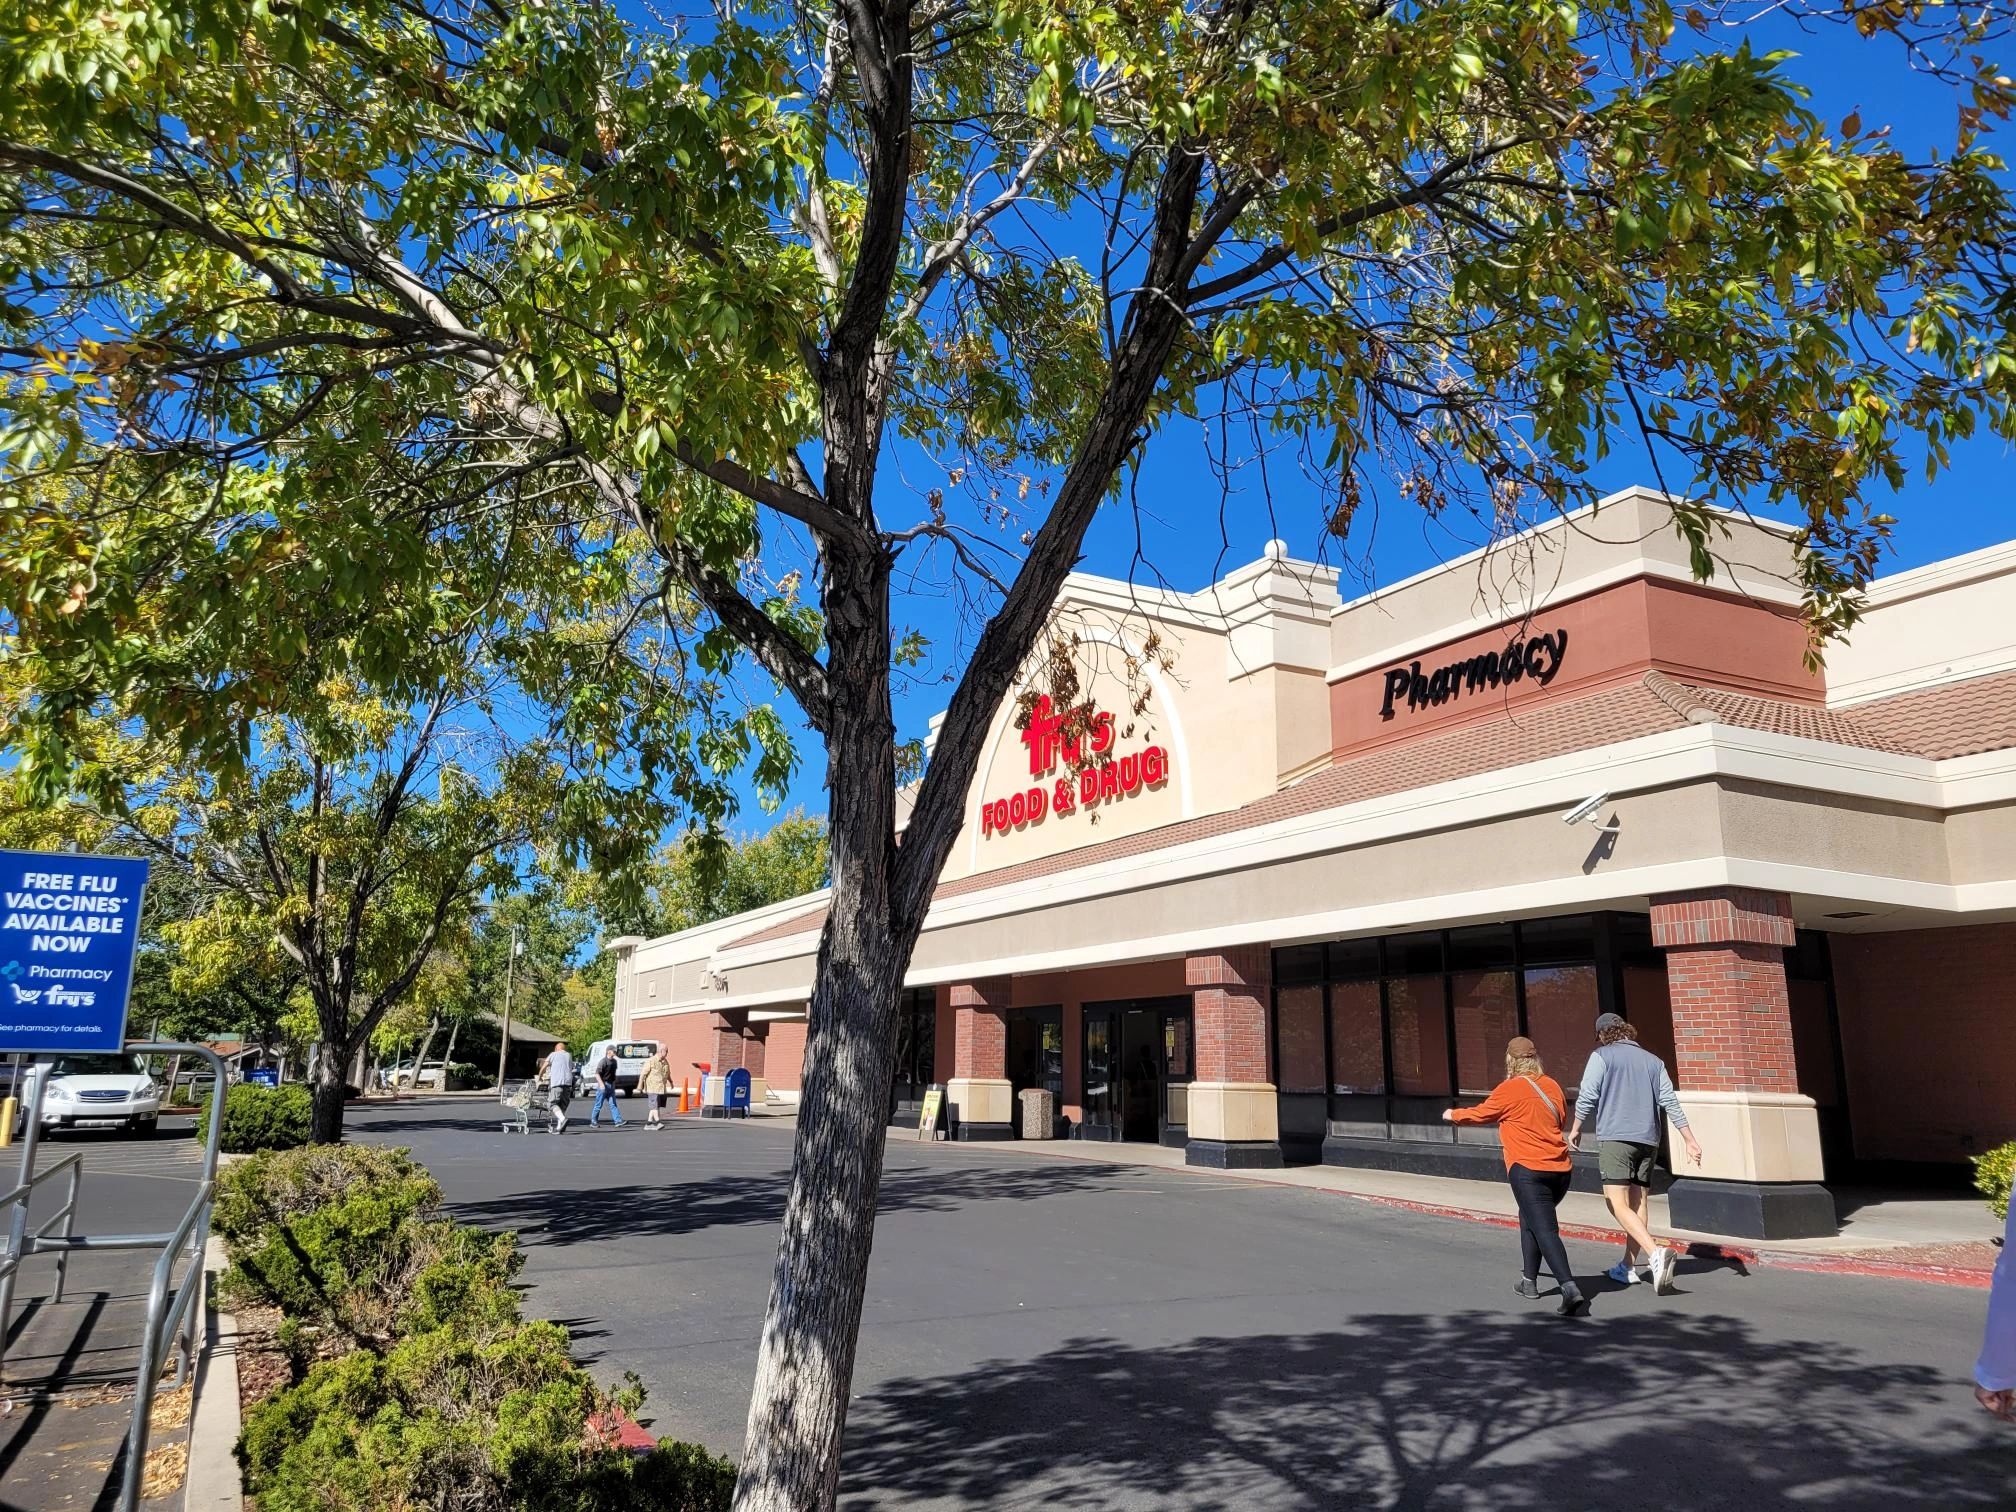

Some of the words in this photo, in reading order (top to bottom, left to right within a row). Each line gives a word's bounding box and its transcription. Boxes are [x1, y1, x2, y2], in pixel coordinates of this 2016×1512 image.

[1379, 629, 1567, 722] Pharmacy
[1021, 694, 1116, 776] frys
[982, 788, 1045, 835] FOOD
[1053, 778, 1073, 813] &
[1080, 745, 1166, 804] DRUG
[23, 872, 74, 891] FREE
[79, 875, 118, 893] FLU
[4, 913, 124, 934] AVAILABLE
[32, 935, 91, 953] NOW
[30, 965, 113, 982] Pharmacy
[14, 1024, 60, 1033] pharmacy
[74, 1025, 103, 1033] details.
